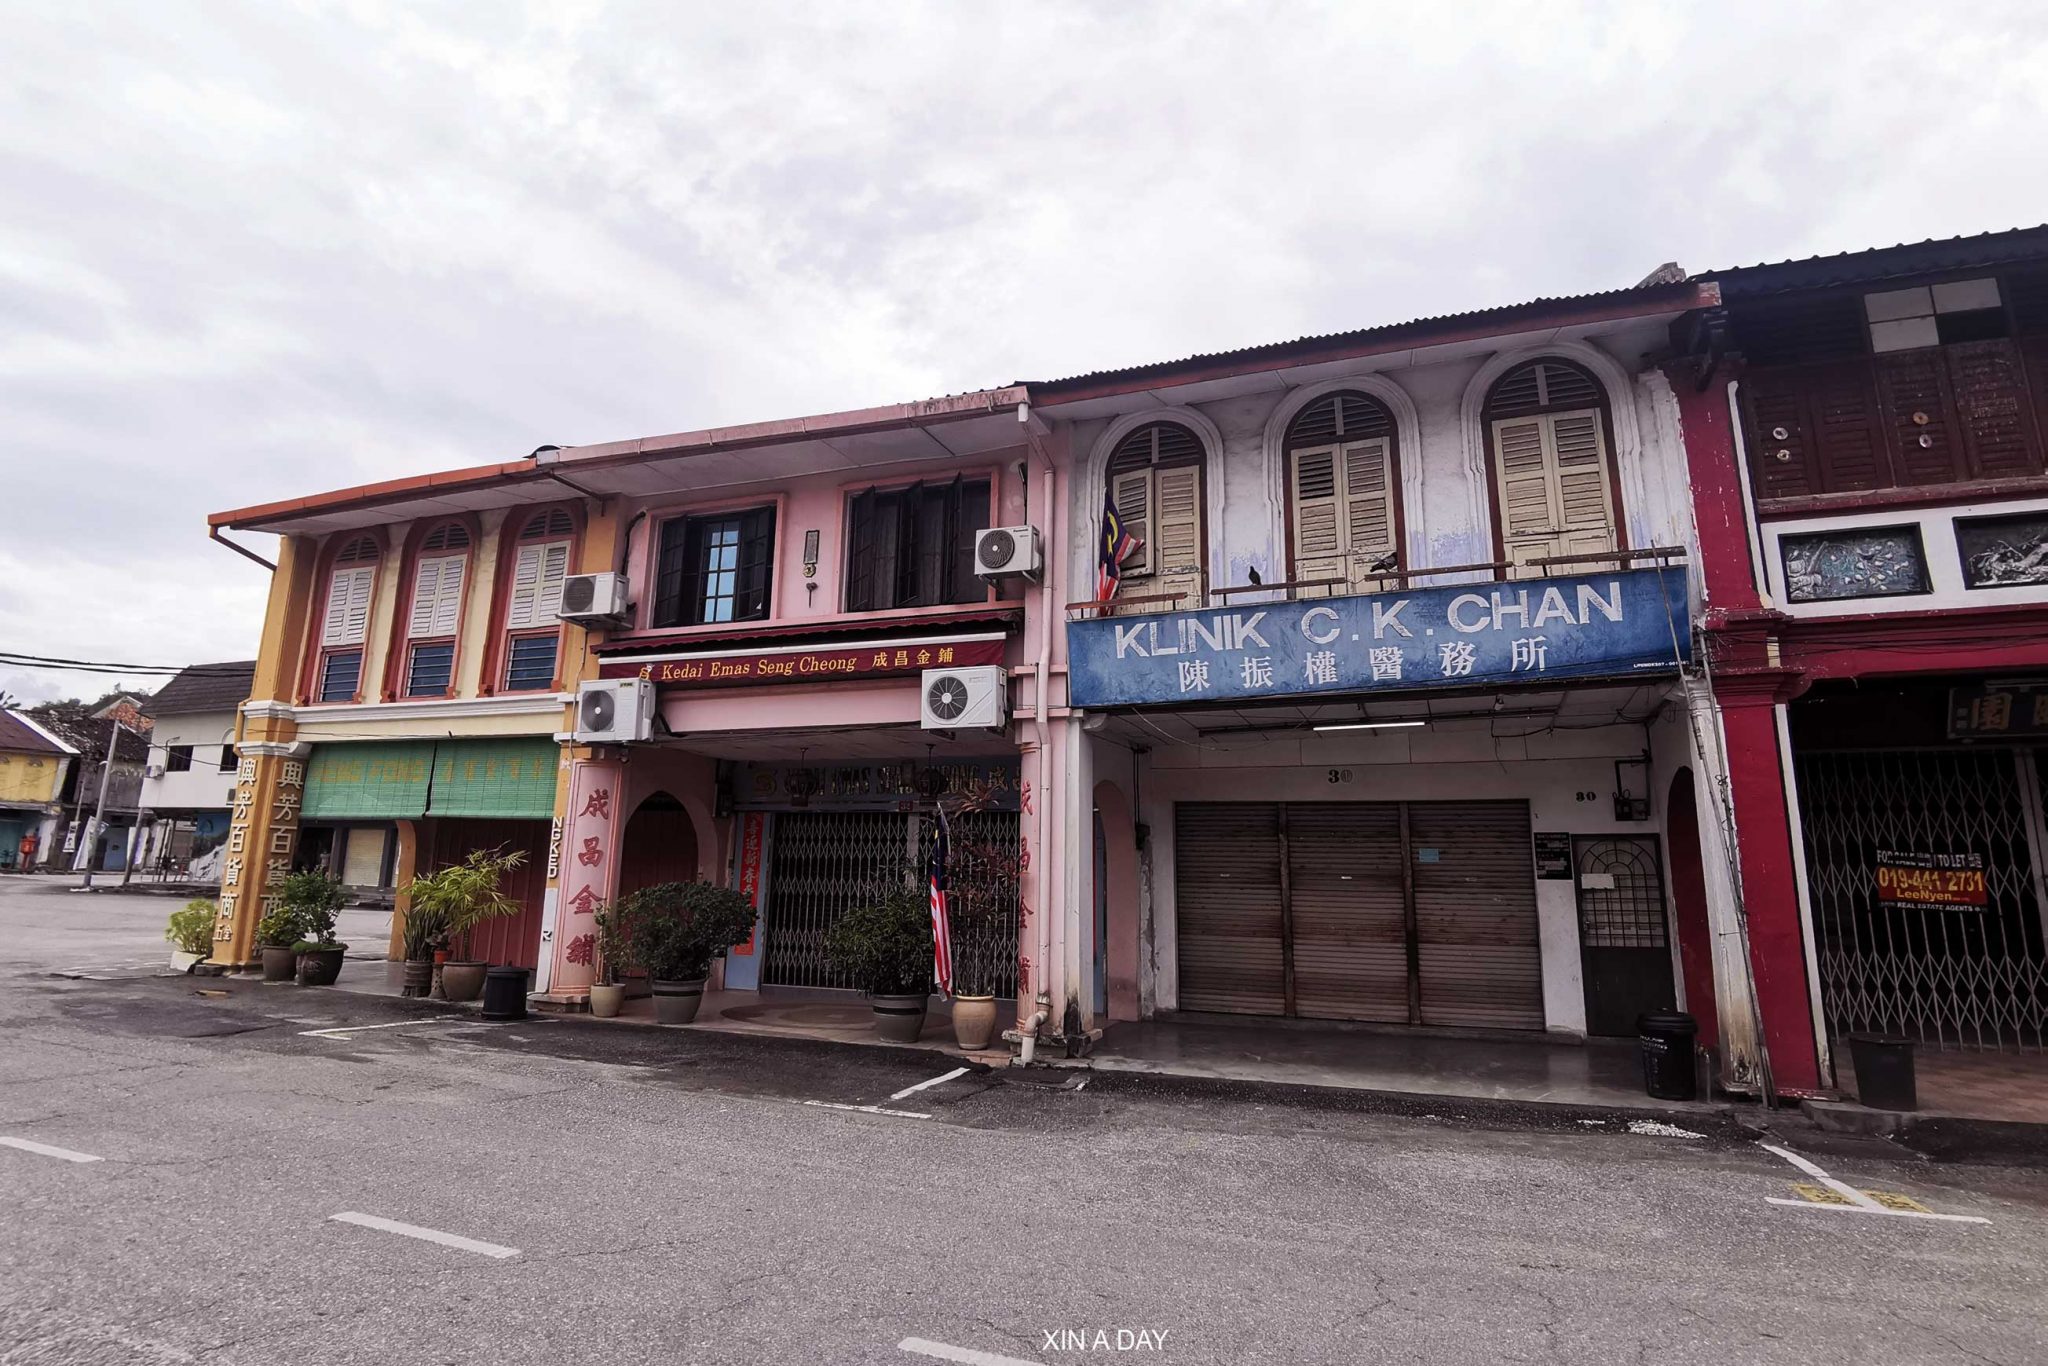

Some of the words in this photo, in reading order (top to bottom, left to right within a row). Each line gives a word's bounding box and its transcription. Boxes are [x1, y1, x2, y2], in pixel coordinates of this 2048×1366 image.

[1115, 611, 1271, 659] KLINIK
[661, 663, 703, 680] Kedai
[710, 661, 750, 678] Emas
[757, 659, 794, 675] Seng
[799, 656, 857, 672] Cheong
[1177, 635, 1548, 693] 陳振權醫務所
[1938, 854, 1949, 867] TO
[1951, 854, 1966, 868] LET
[1946, 870, 1984, 892] 2731
[1896, 888, 1952, 902] LeeNyen
[1897, 902, 1916, 910] REAL
[1917, 903, 1943, 911] ESTATE
[1945, 904, 1973, 912] AGENTS
